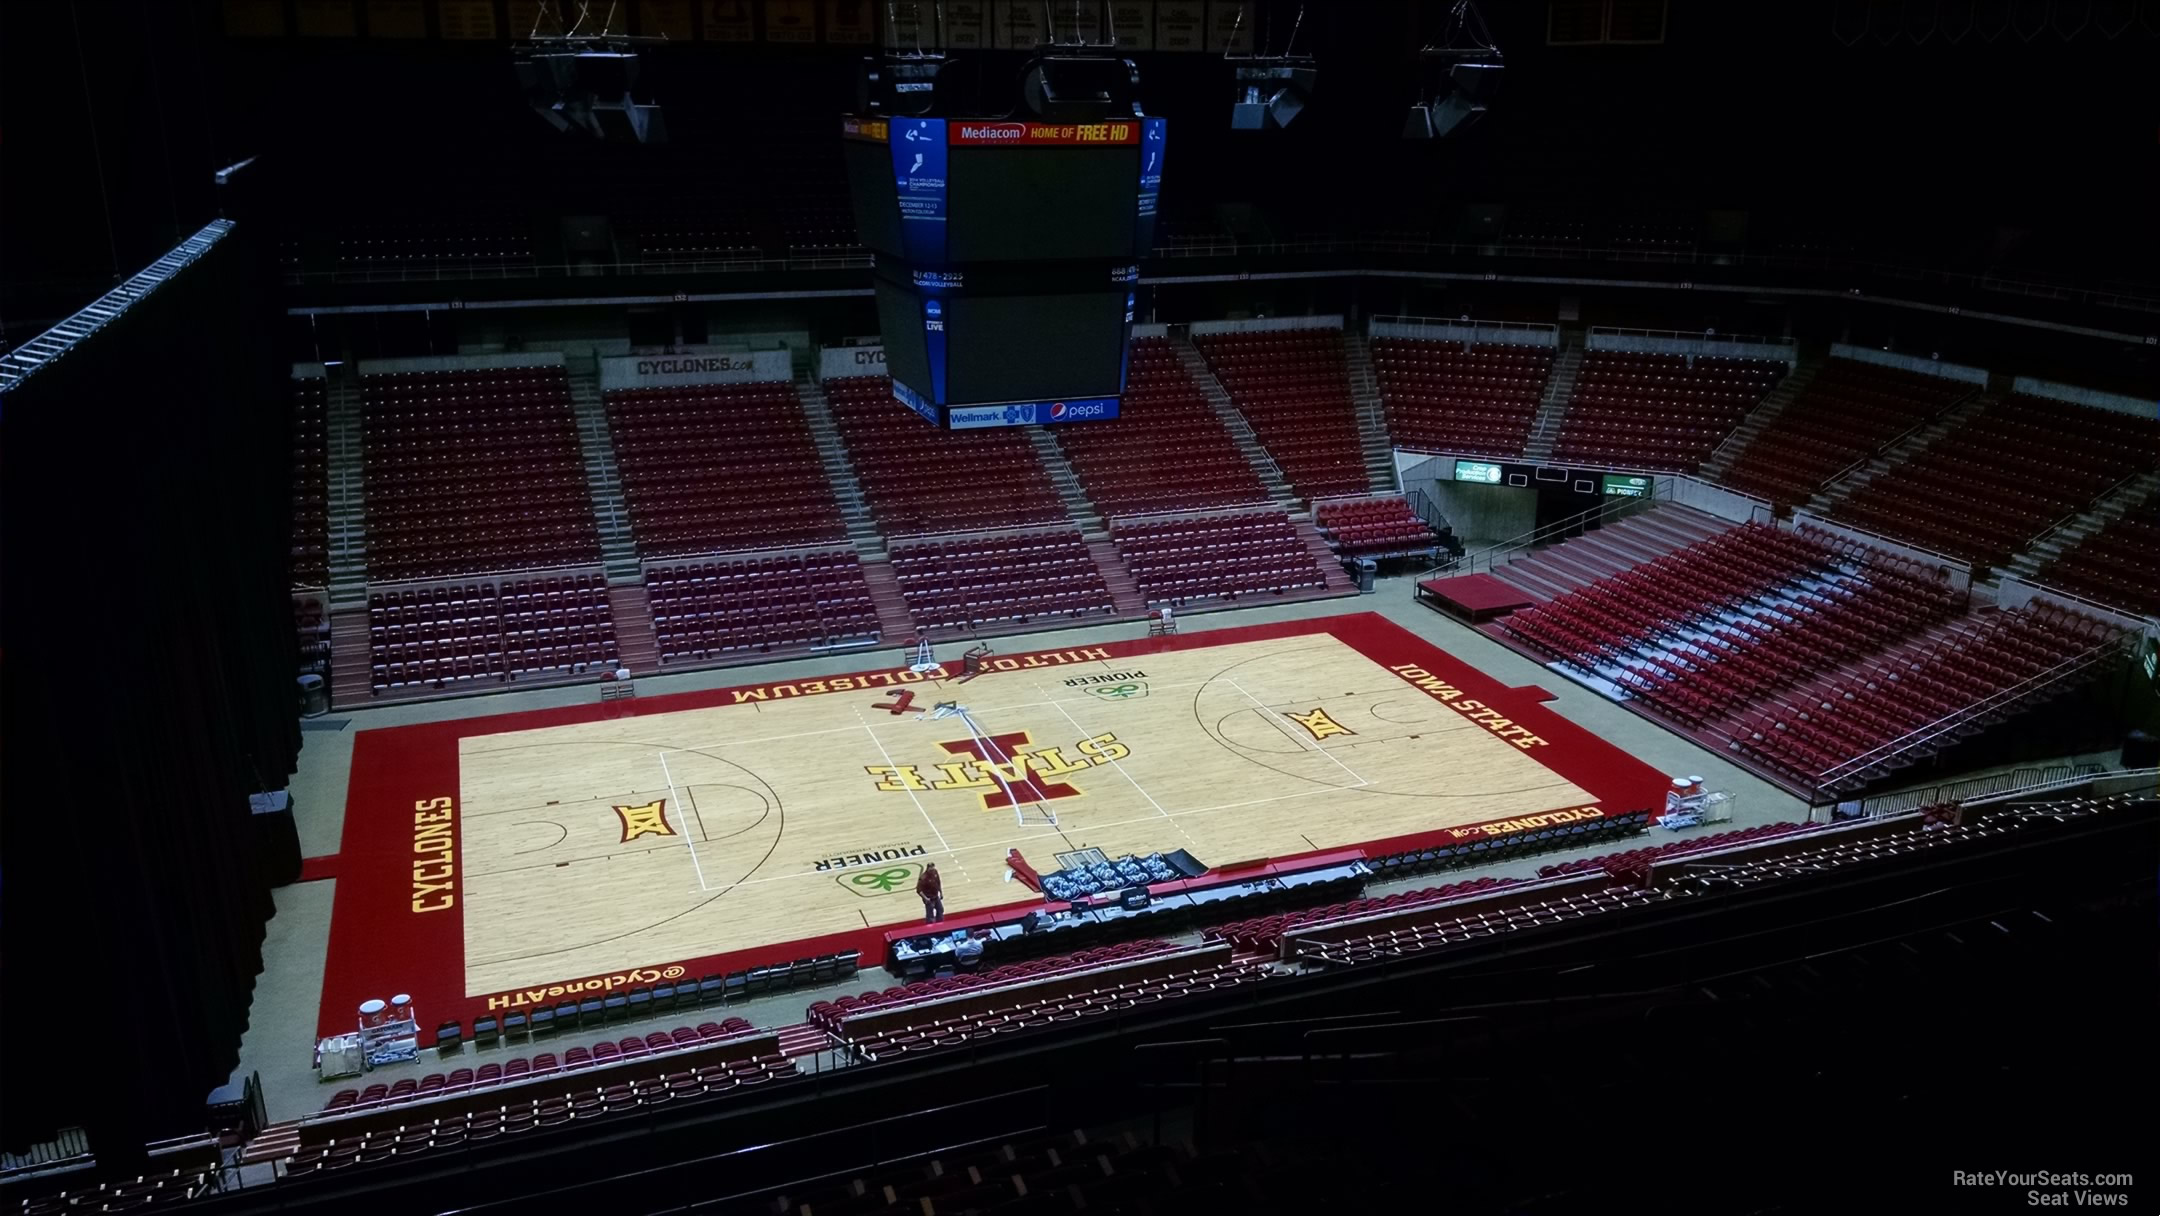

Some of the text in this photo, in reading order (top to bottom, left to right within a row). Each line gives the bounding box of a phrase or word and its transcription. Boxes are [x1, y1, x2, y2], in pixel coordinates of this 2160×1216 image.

[961, 124, 1129, 141] Mediacom HOME OF FREE HD
[951, 411, 999, 423] Wellmark
[1069, 402, 1104, 418] pepsi
[1063, 670, 1148, 687] PIONEER
[1390, 662, 1550, 749] IOWA STATE
[864, 732, 1131, 791] STATE
[412, 796, 454, 913] CYCLONES
[813, 844, 928, 872] PIONEER
[488, 965, 686, 1011] @CycloneATH
